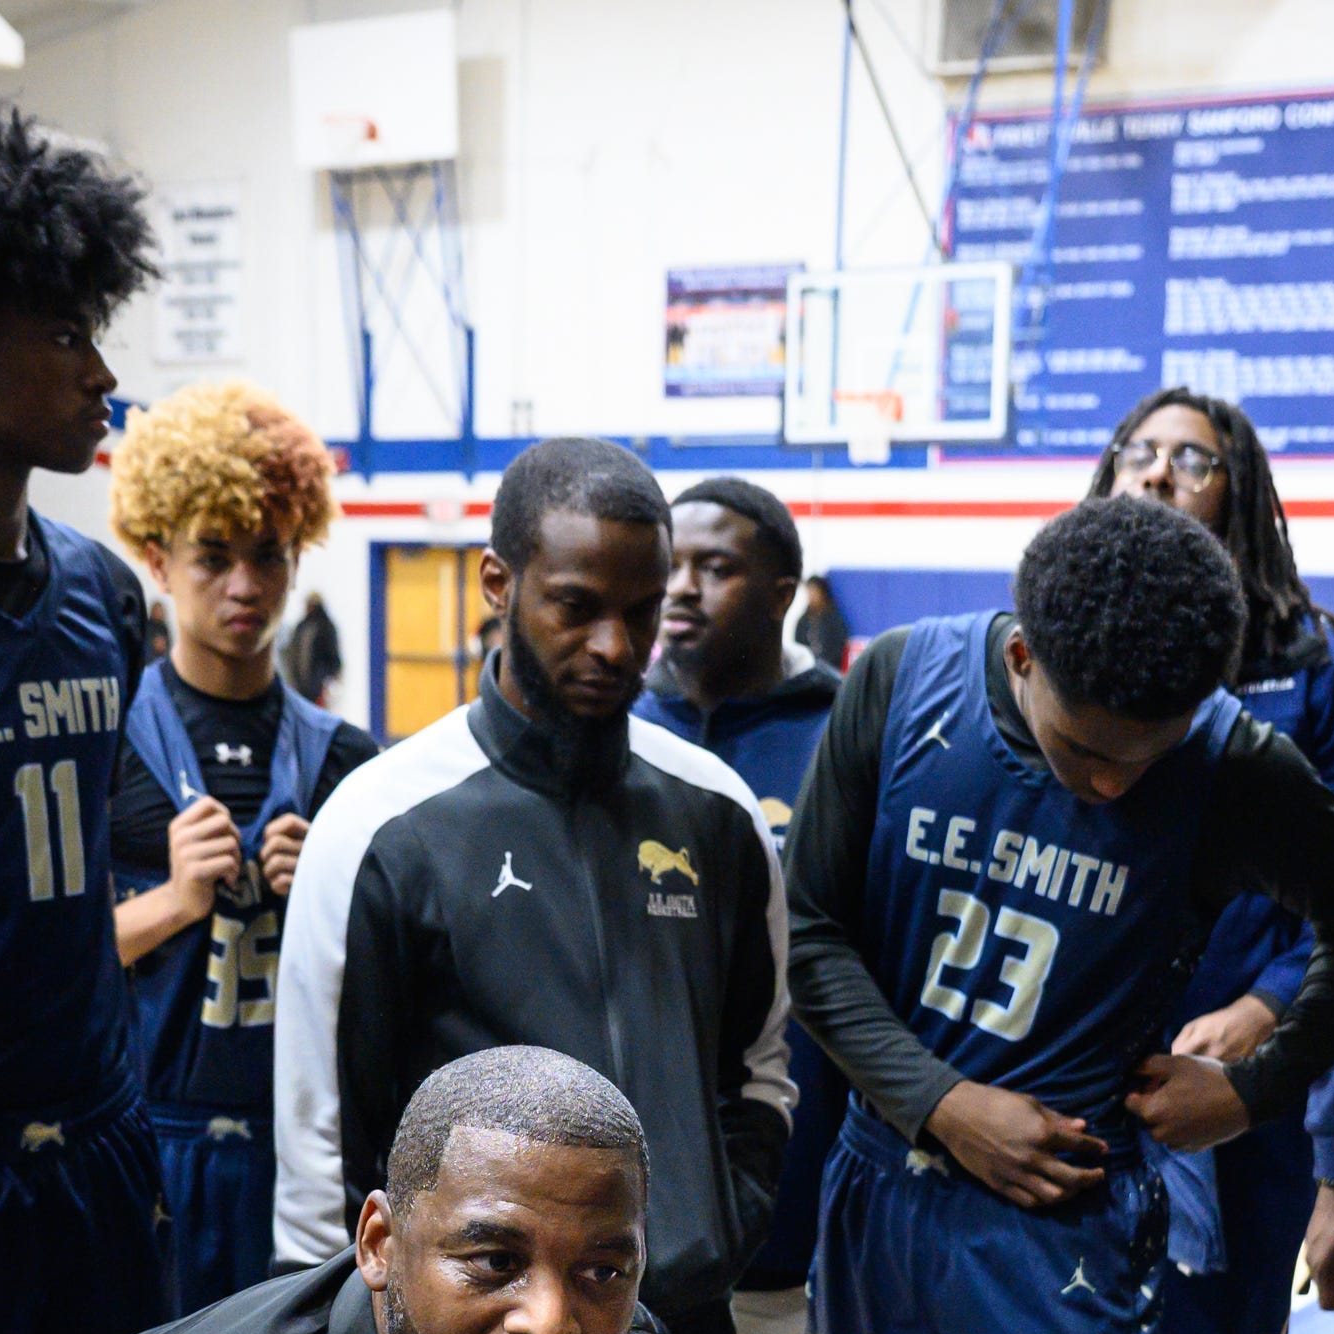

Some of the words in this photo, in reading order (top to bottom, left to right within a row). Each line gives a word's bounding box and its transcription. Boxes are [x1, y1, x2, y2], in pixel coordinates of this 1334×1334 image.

[19, 676, 121, 739] SMITH
[14, 759, 86, 902] 11
[905, 806, 983, 874] E.E.
[987, 829, 1130, 917] SMITH
[920, 887, 1060, 1042] 23
